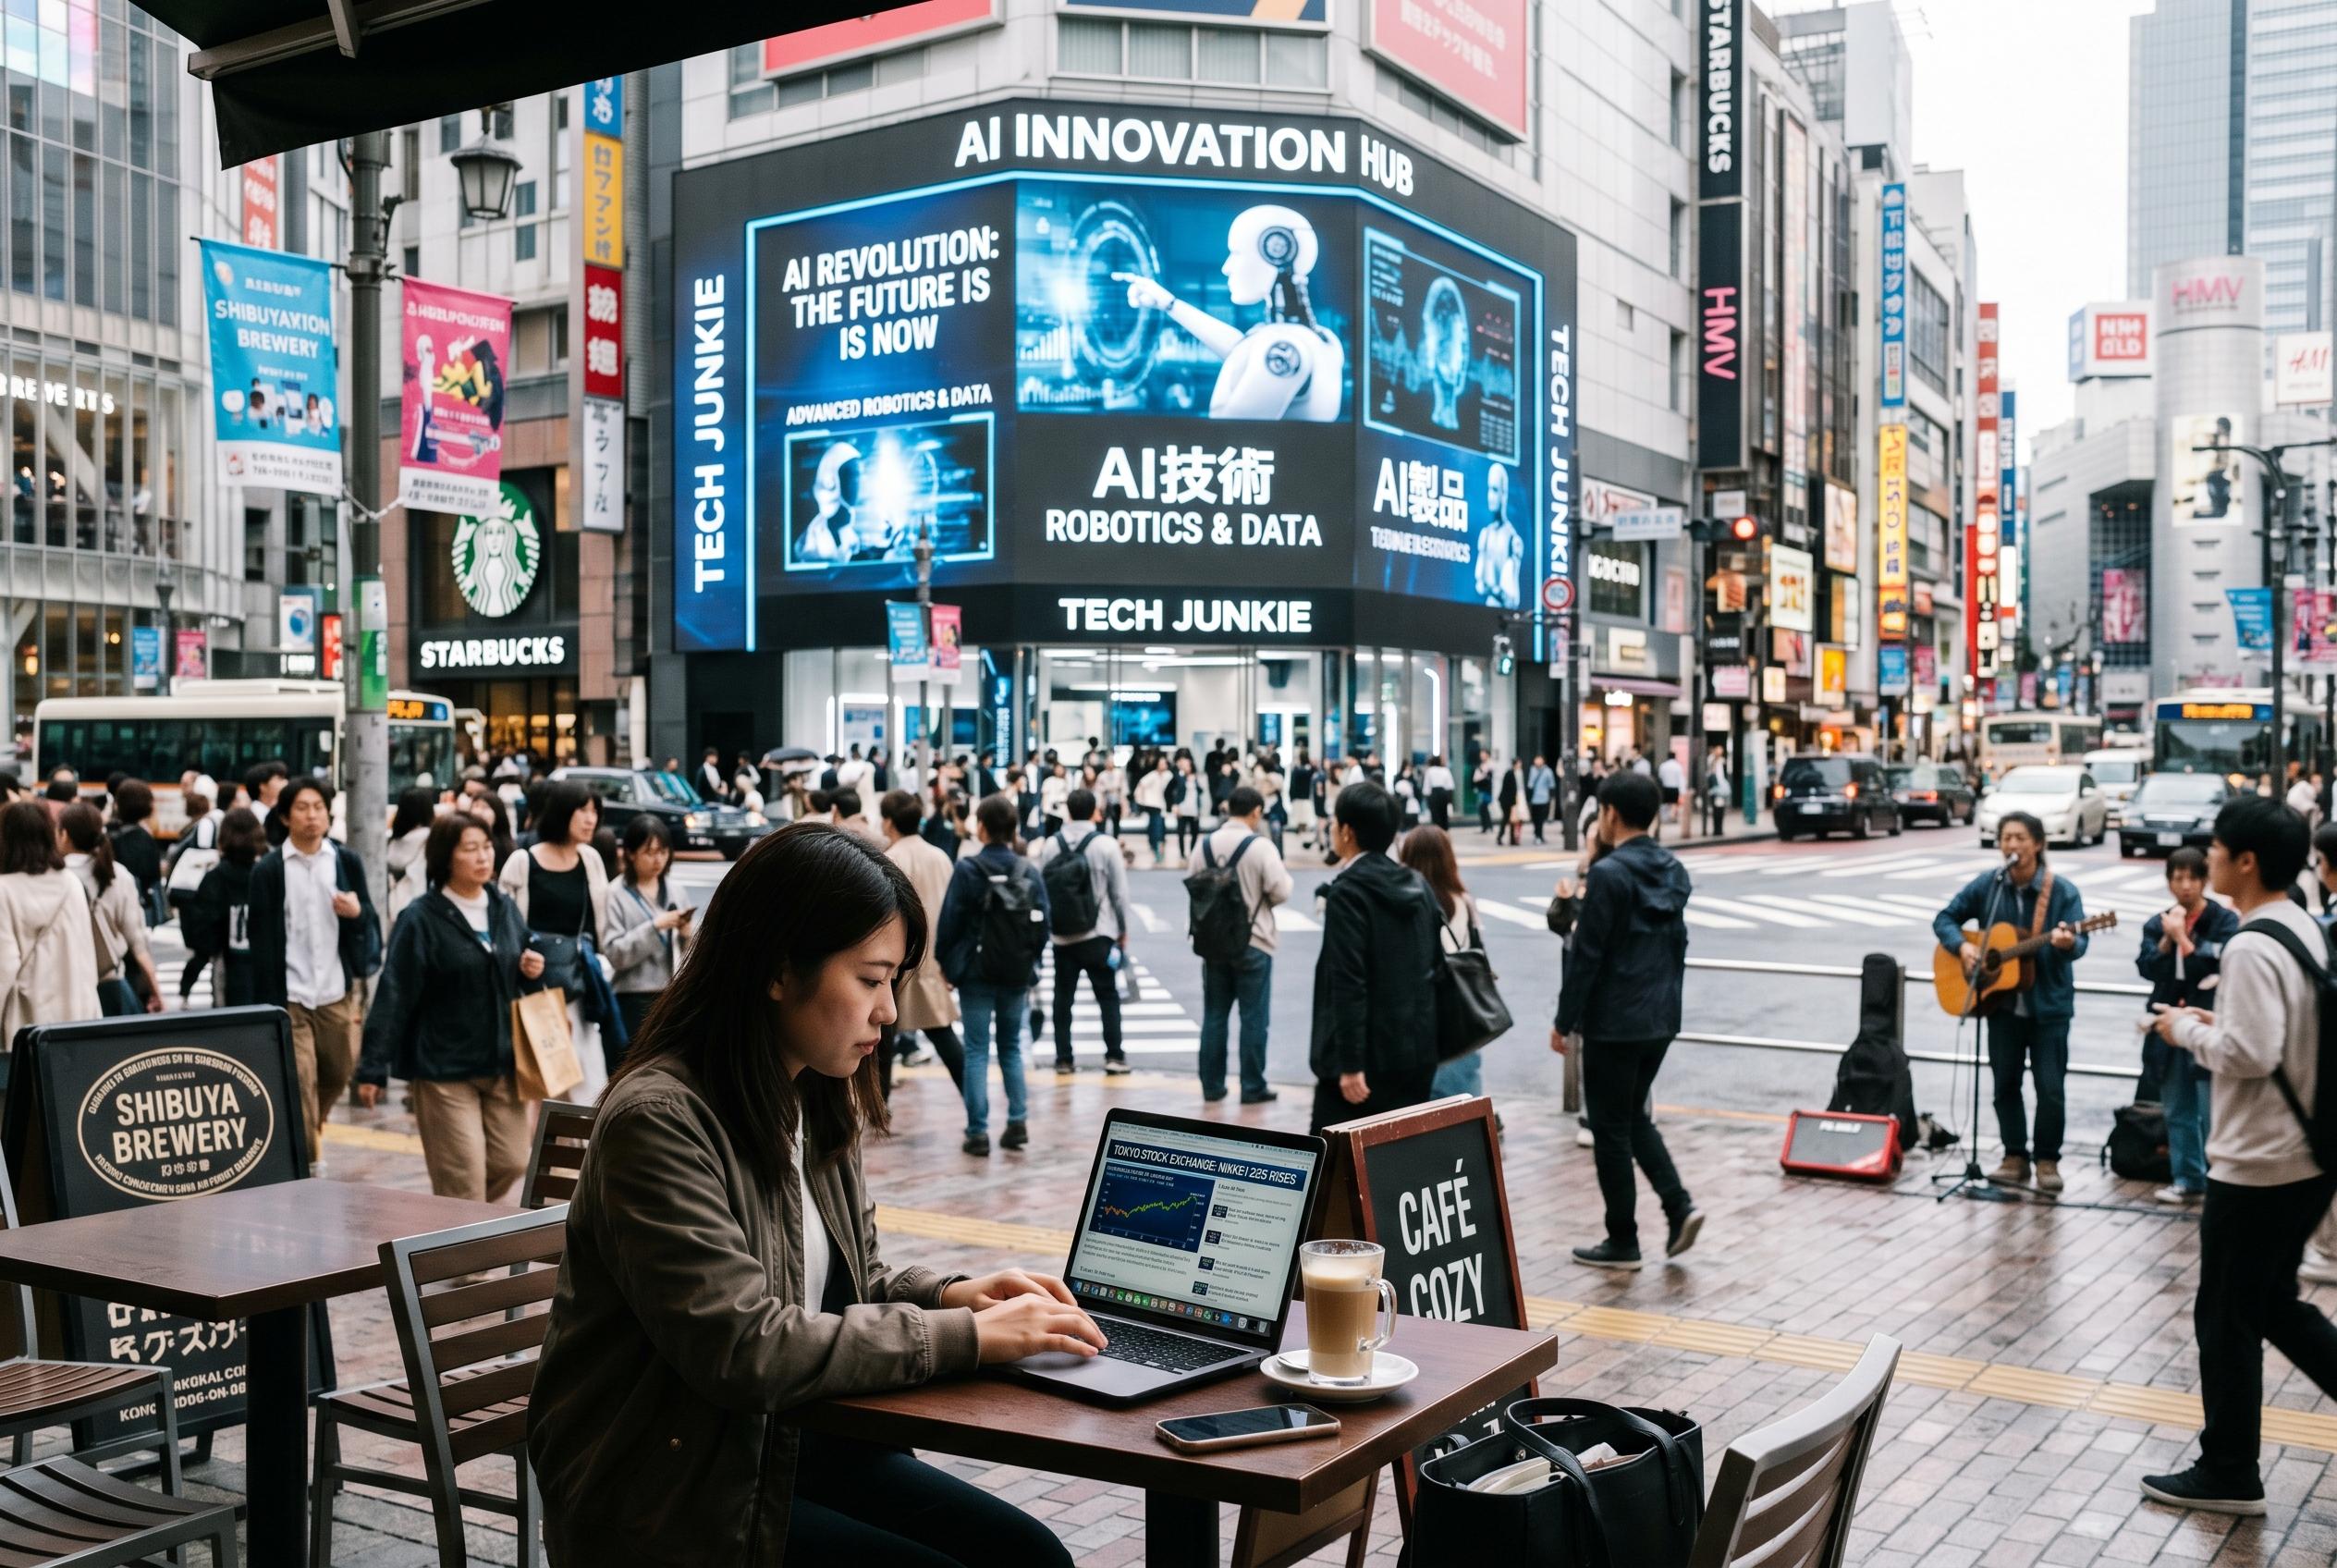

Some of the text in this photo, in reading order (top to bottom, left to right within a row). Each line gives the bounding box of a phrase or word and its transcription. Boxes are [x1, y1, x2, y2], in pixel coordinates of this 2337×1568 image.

[955, 114, 1413, 196] AI INNOVATION HUB
[782, 226, 999, 292] AI REVOLUTION:
[790, 267, 990, 328] THE FUTURE IS
[2172, 276, 2245, 306] HMV
[238, 328, 318, 359] BREWERY
[840, 314, 938, 361] IS NOW
[1705, 287, 1736, 380] HMV
[786, 384, 993, 425] ADVANCED ROBOTICS & DATA
[694, 275, 725, 593] TECH JUNKIE
[1550, 325, 1570, 580] TECH JUNKI
[1092, 445, 1275, 505] AI技術
[1373, 458, 1468, 533] AI製品
[1046, 509, 1323, 546] ROBOTICS & DATA
[1058, 598, 1312, 633] TECH JUNKIE
[421, 636, 565, 668] STARBUCKS
[116, 1083, 240, 1126] SHIBUYA
[113, 1117, 246, 1164] BREWERY
[1114, 1145, 1141, 1158] TOKYO
[1140, 1149, 1168, 1163] STOCK
[1169, 1154, 1217, 1172] EXCHANGE:
[1268, 1170, 1297, 1185] RISES
[1399, 1158, 1476, 1256] CAFÉ
[1410, 1253, 1485, 1323] COZY
